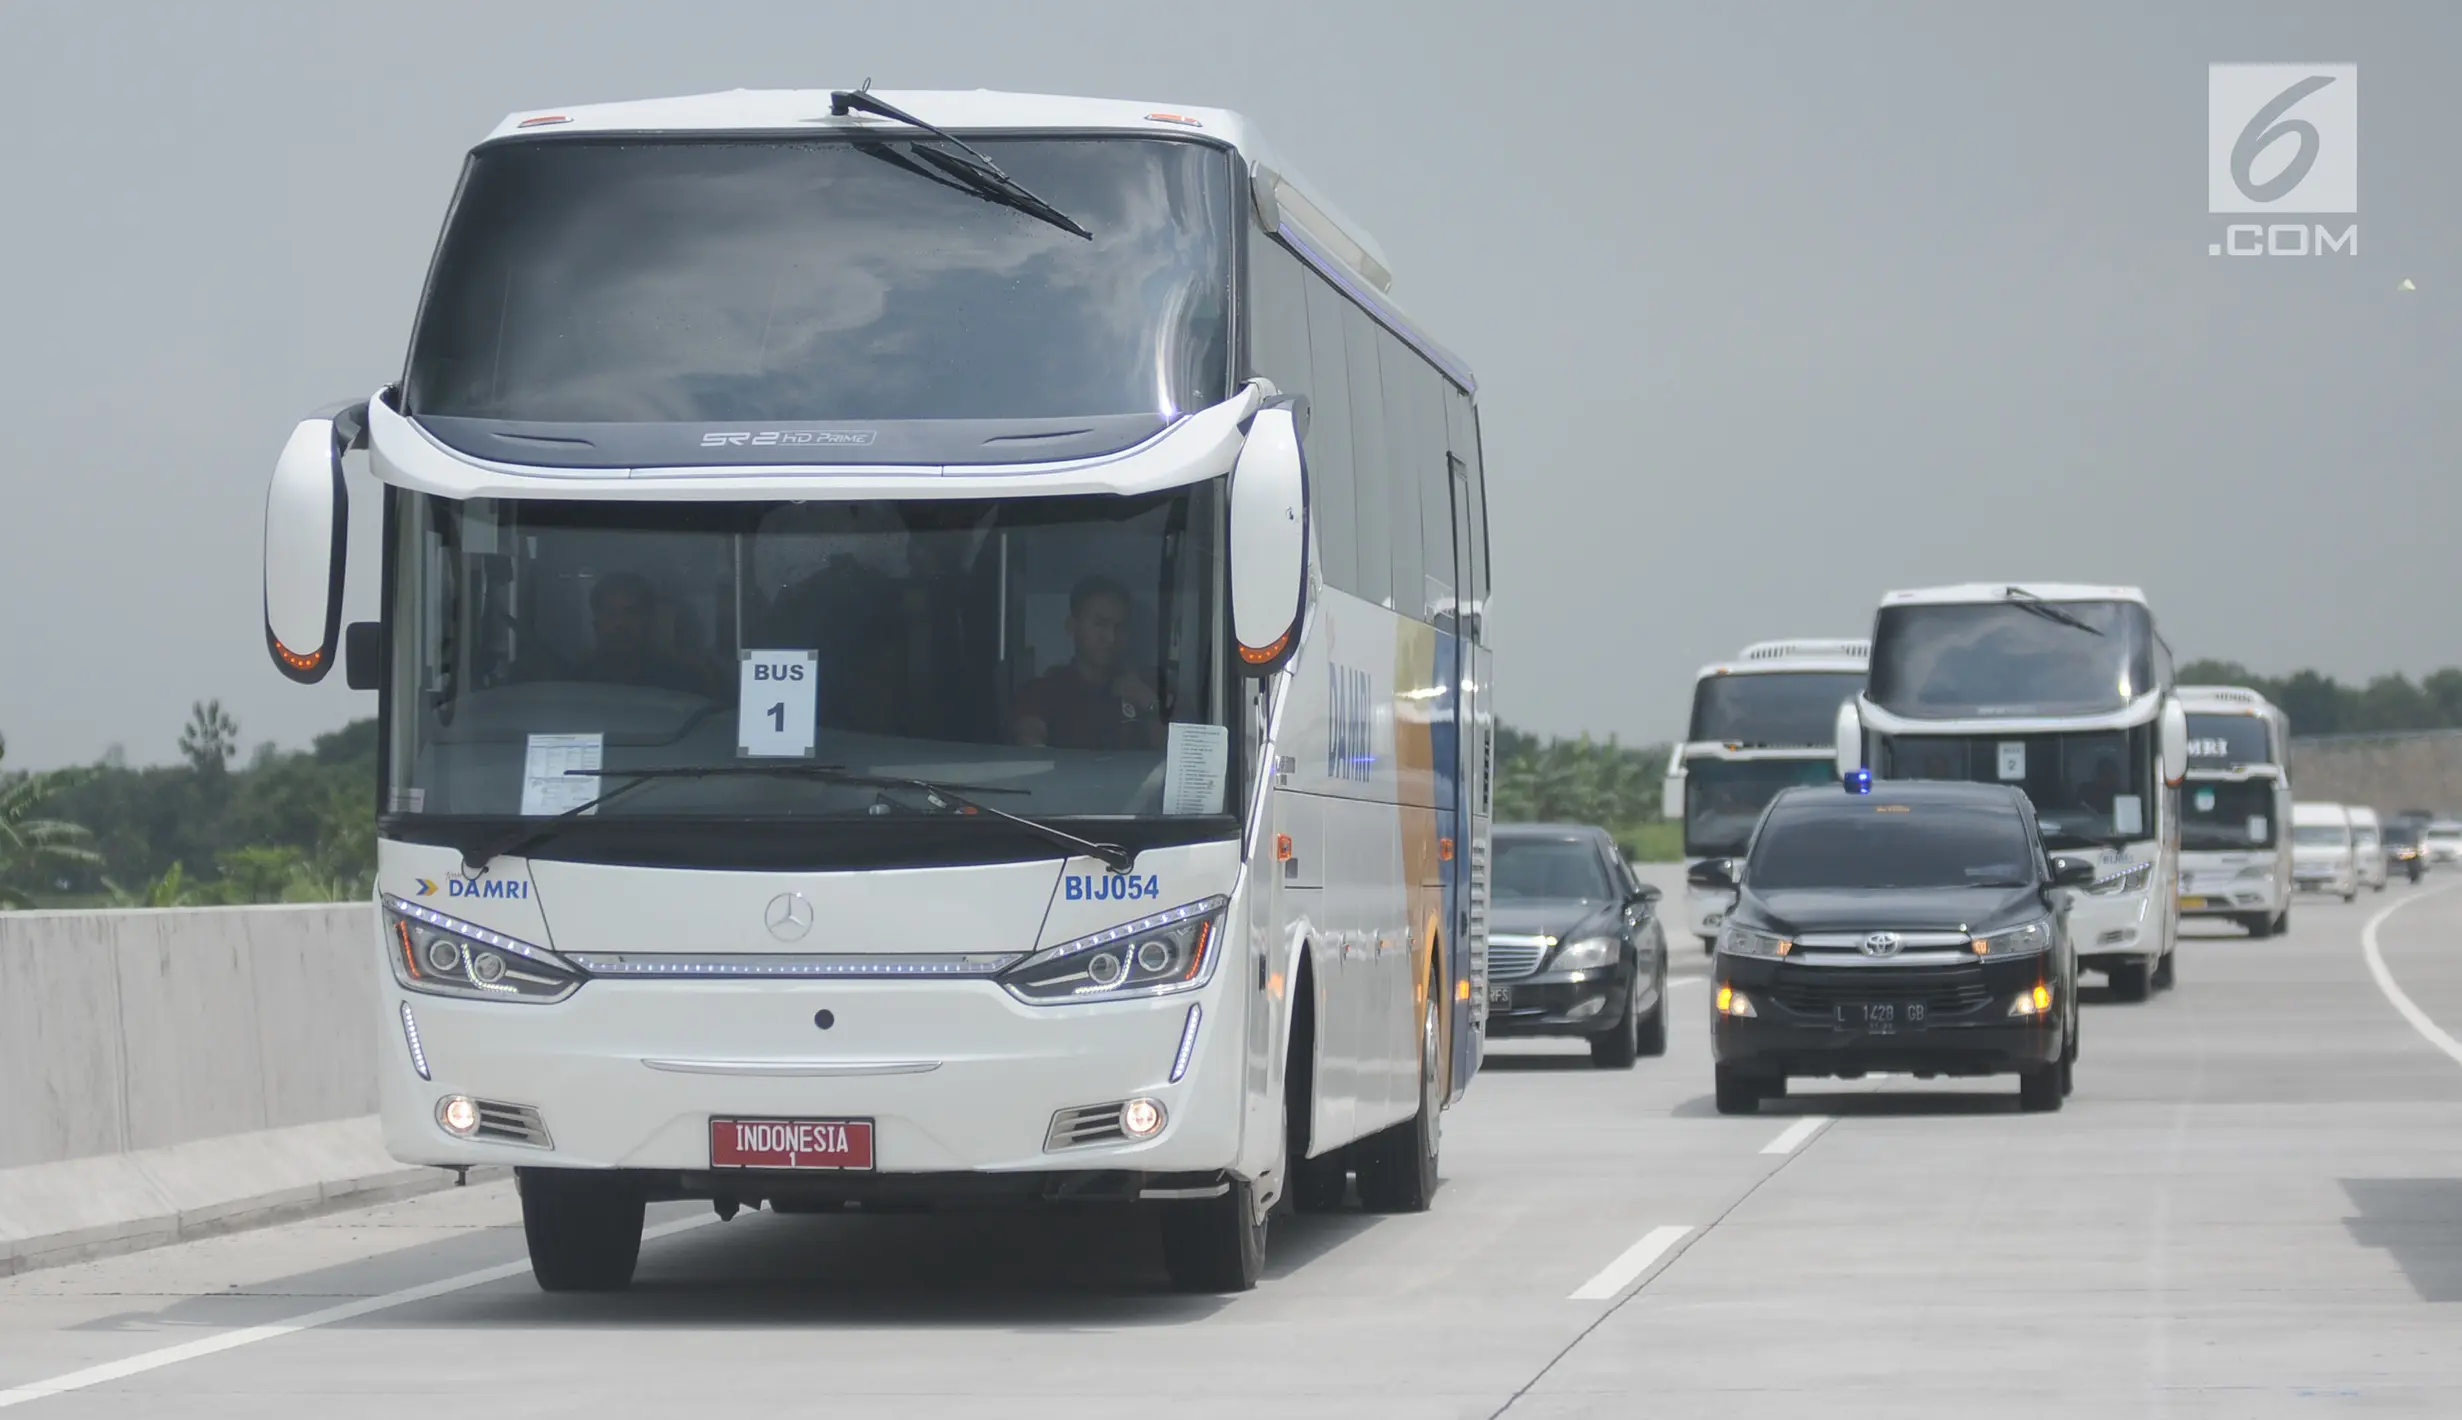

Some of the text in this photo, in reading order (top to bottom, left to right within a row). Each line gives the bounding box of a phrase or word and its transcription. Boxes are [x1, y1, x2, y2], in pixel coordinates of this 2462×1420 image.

[753, 663, 805, 682] BUS
[766, 701, 786, 733] 1
[448, 879, 529, 900] DAMRI
[1065, 874, 1160, 900] BIJ054
[1837, 1005, 1846, 1022] L
[1863, 1004, 1895, 1021] 1428
[735, 1124, 849, 1153] INDONESIA
[788, 1151, 797, 1168] 1
